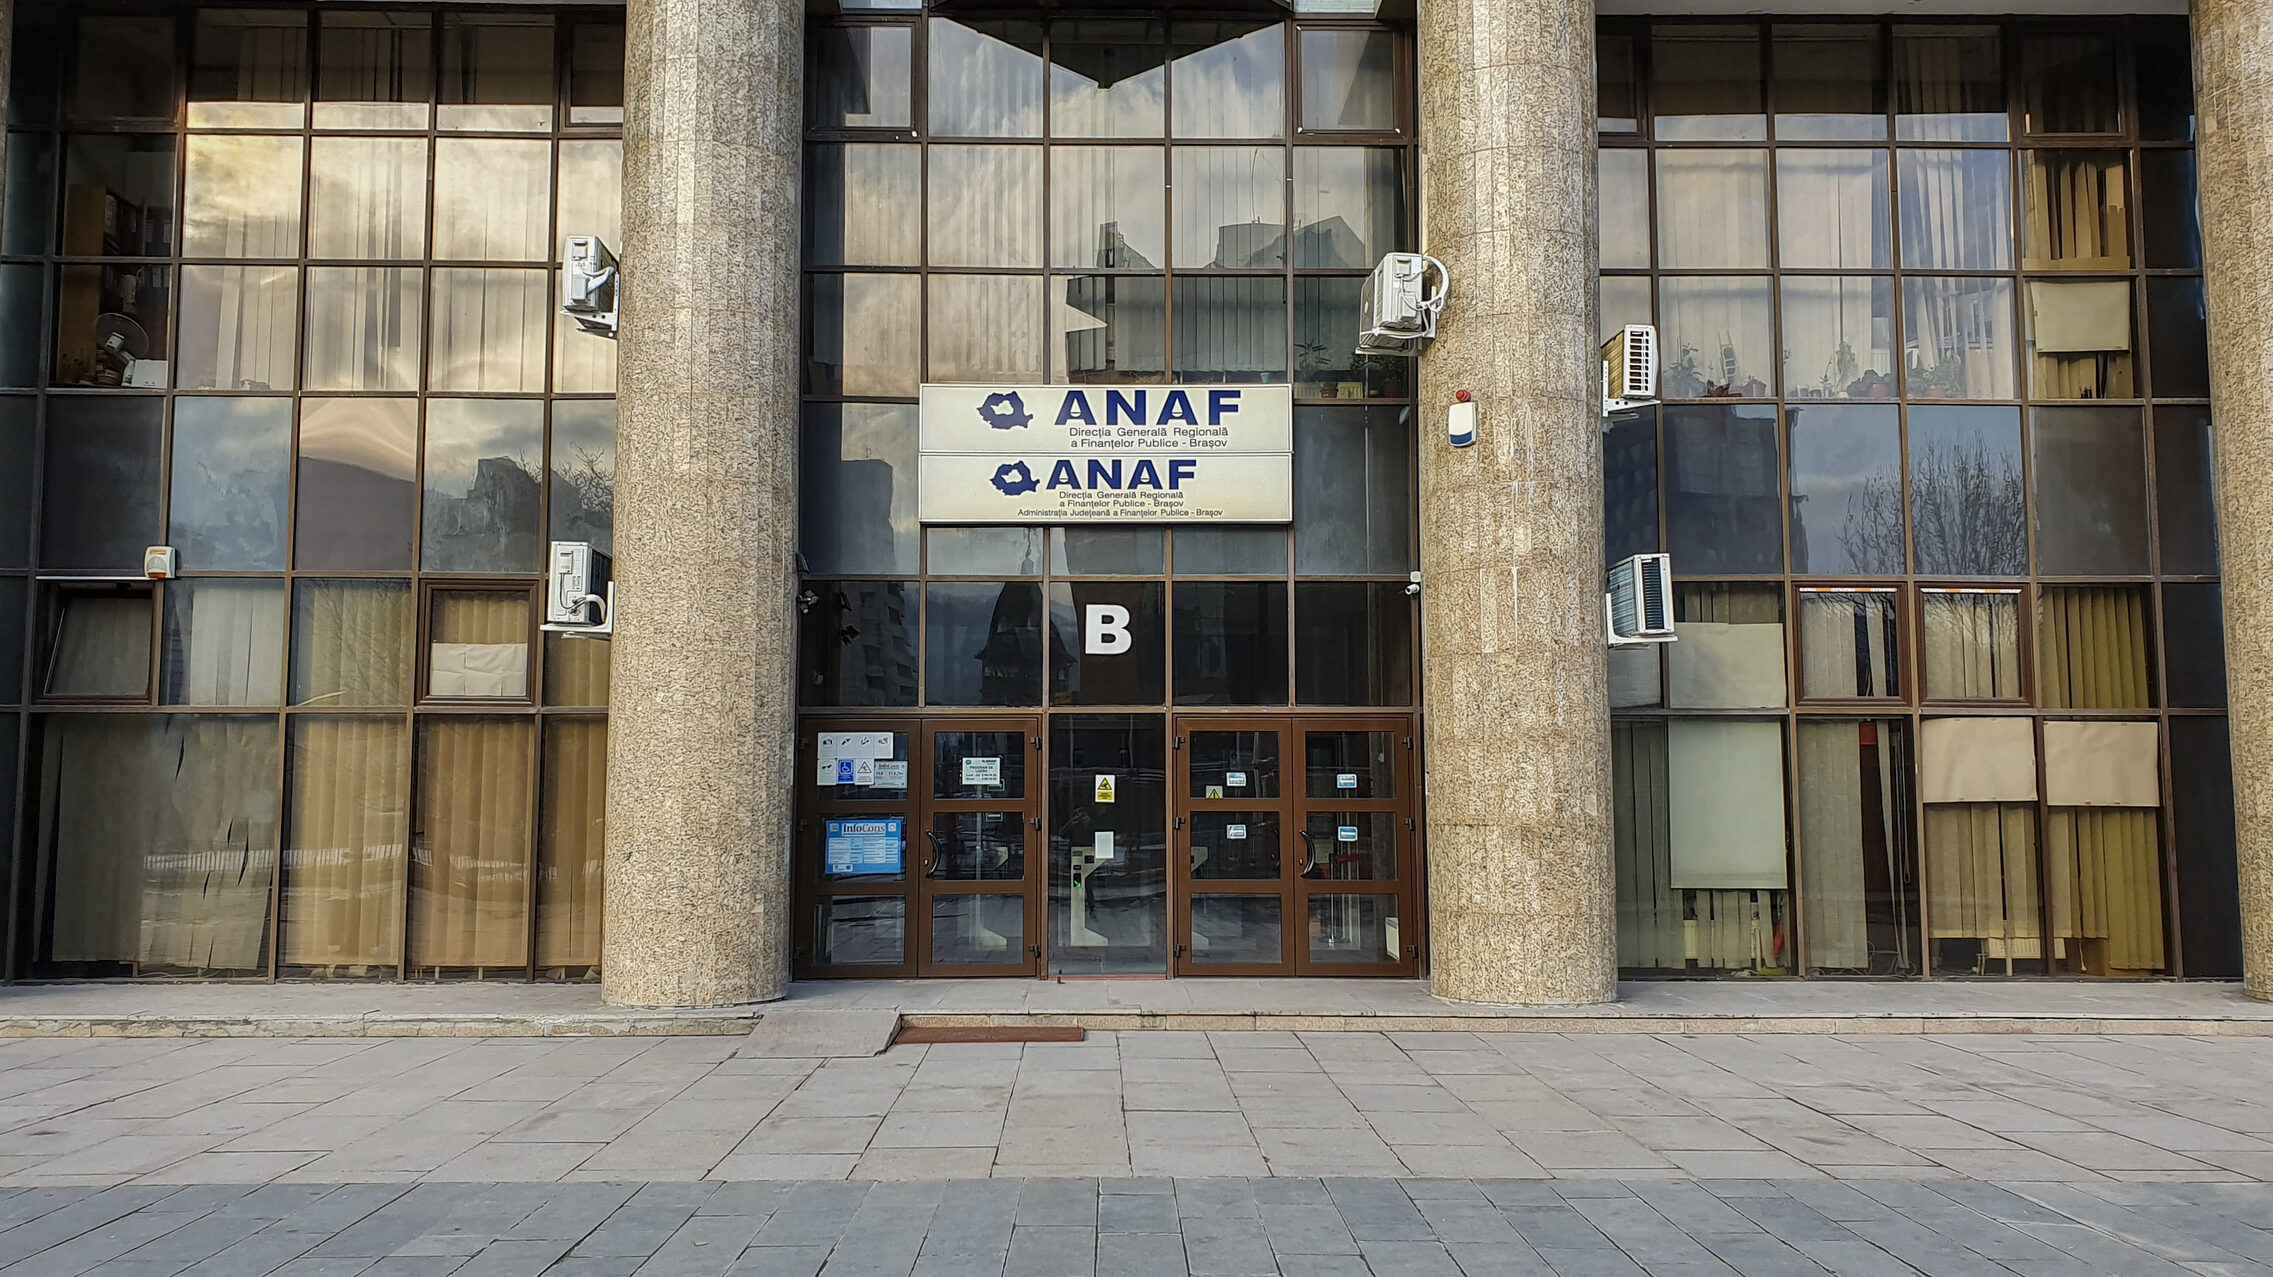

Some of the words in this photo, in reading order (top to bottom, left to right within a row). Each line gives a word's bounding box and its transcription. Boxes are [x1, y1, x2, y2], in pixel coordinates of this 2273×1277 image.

[1054, 389, 1242, 426] ANAF
[1069, 427, 1111, 439] Direcția
[1116, 427, 1167, 437] Generală
[1173, 427, 1229, 439] Regională
[1070, 440, 1078, 448] a
[1081, 438, 1135, 450] Finanțelor
[1138, 438, 1179, 448] Publice
[1189, 438, 1228, 450] Brașov
[1045, 459, 1197, 490] ANAF
[1096, 491, 1137, 499] Generală
[1140, 491, 1184, 500] Regională
[1113, 500, 1146, 508] Publice
[1160, 509, 1190, 517] Publice
[1085, 604, 1132, 655] B
[843, 823, 885, 833] InfoCons
